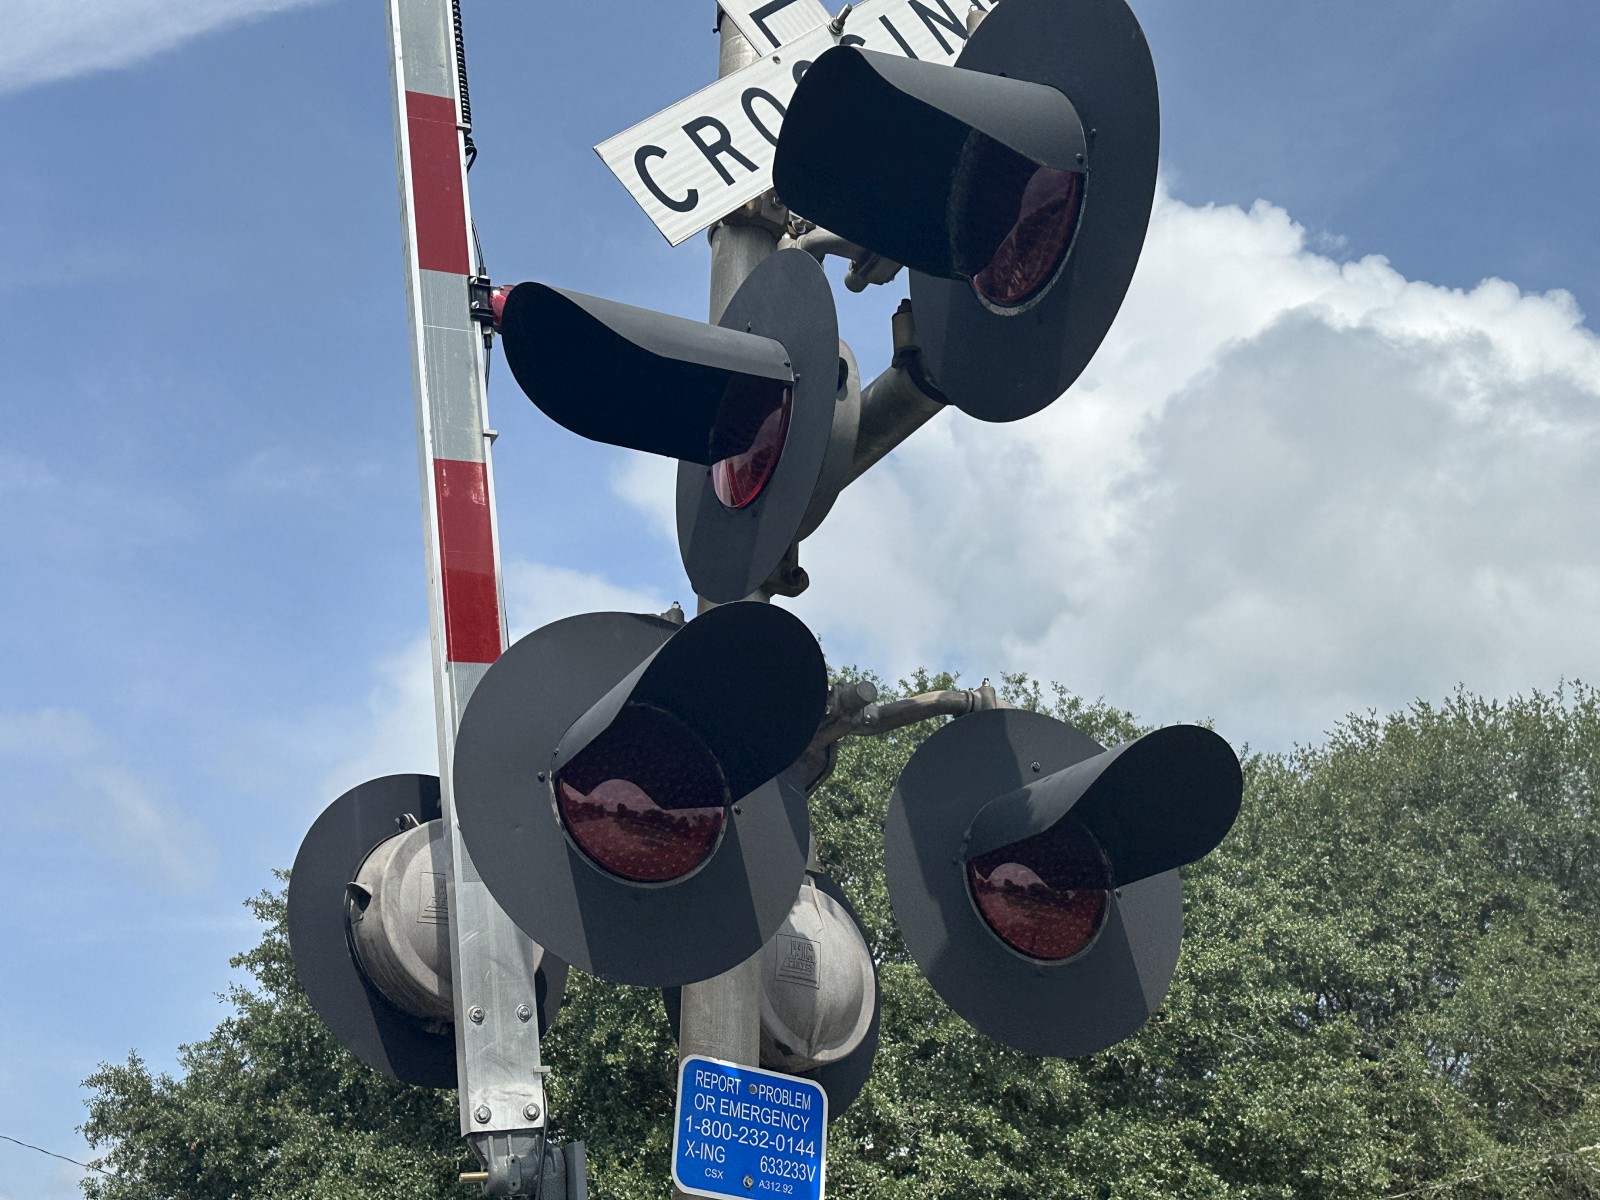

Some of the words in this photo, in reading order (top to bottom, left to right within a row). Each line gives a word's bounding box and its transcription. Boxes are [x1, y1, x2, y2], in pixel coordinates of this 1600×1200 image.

[634, 0, 999, 213] CROIN
[695, 1069, 742, 1095] REPORT
[758, 1084, 811, 1111] PROBLEM
[694, 1093, 716, 1113] OR
[719, 1098, 810, 1133] EMERGENCY
[685, 1115, 816, 1158] 1-800-232-0144
[685, 1139, 726, 1163] X-ING
[760, 1155, 817, 1182] 633233V
[704, 1168, 724, 1180] CSX
